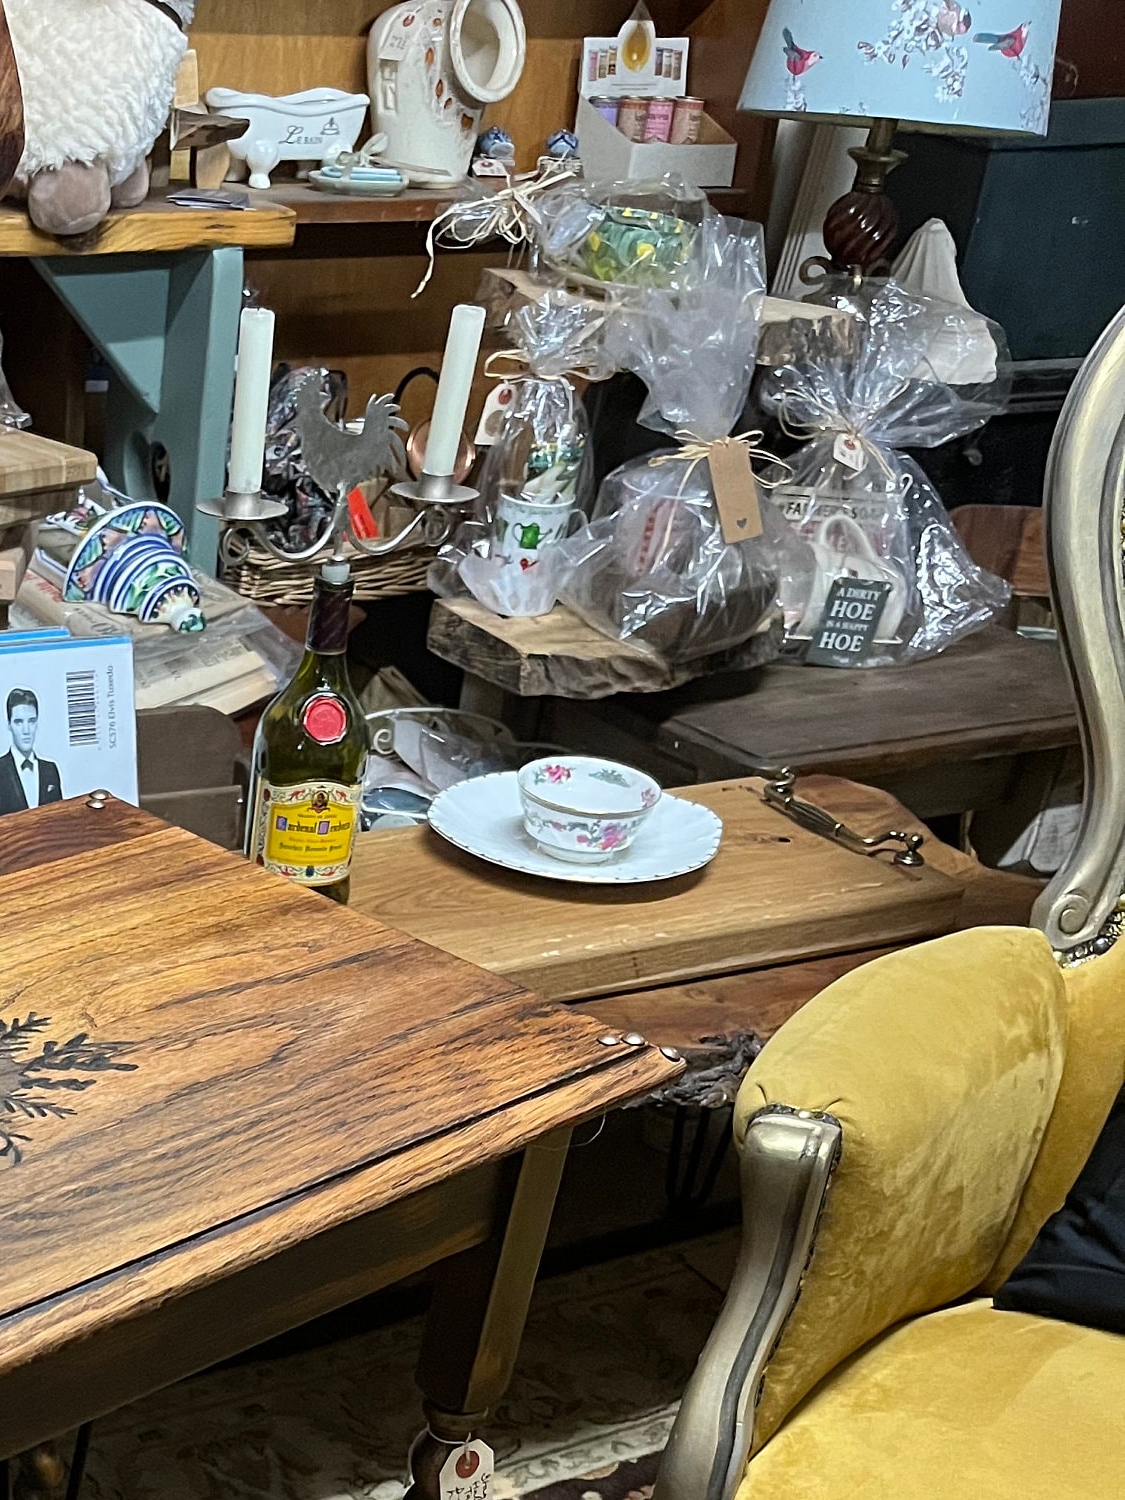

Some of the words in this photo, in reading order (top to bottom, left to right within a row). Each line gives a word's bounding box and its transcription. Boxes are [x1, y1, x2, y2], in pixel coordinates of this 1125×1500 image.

[836, 587, 845, 597] A
[845, 588, 882, 601] DIRTY
[830, 600, 876, 621] HOE
[818, 631, 864, 652] HOE
[106, 665, 115, 698] Tuxedo
[107, 699, 116, 720] Elvis
